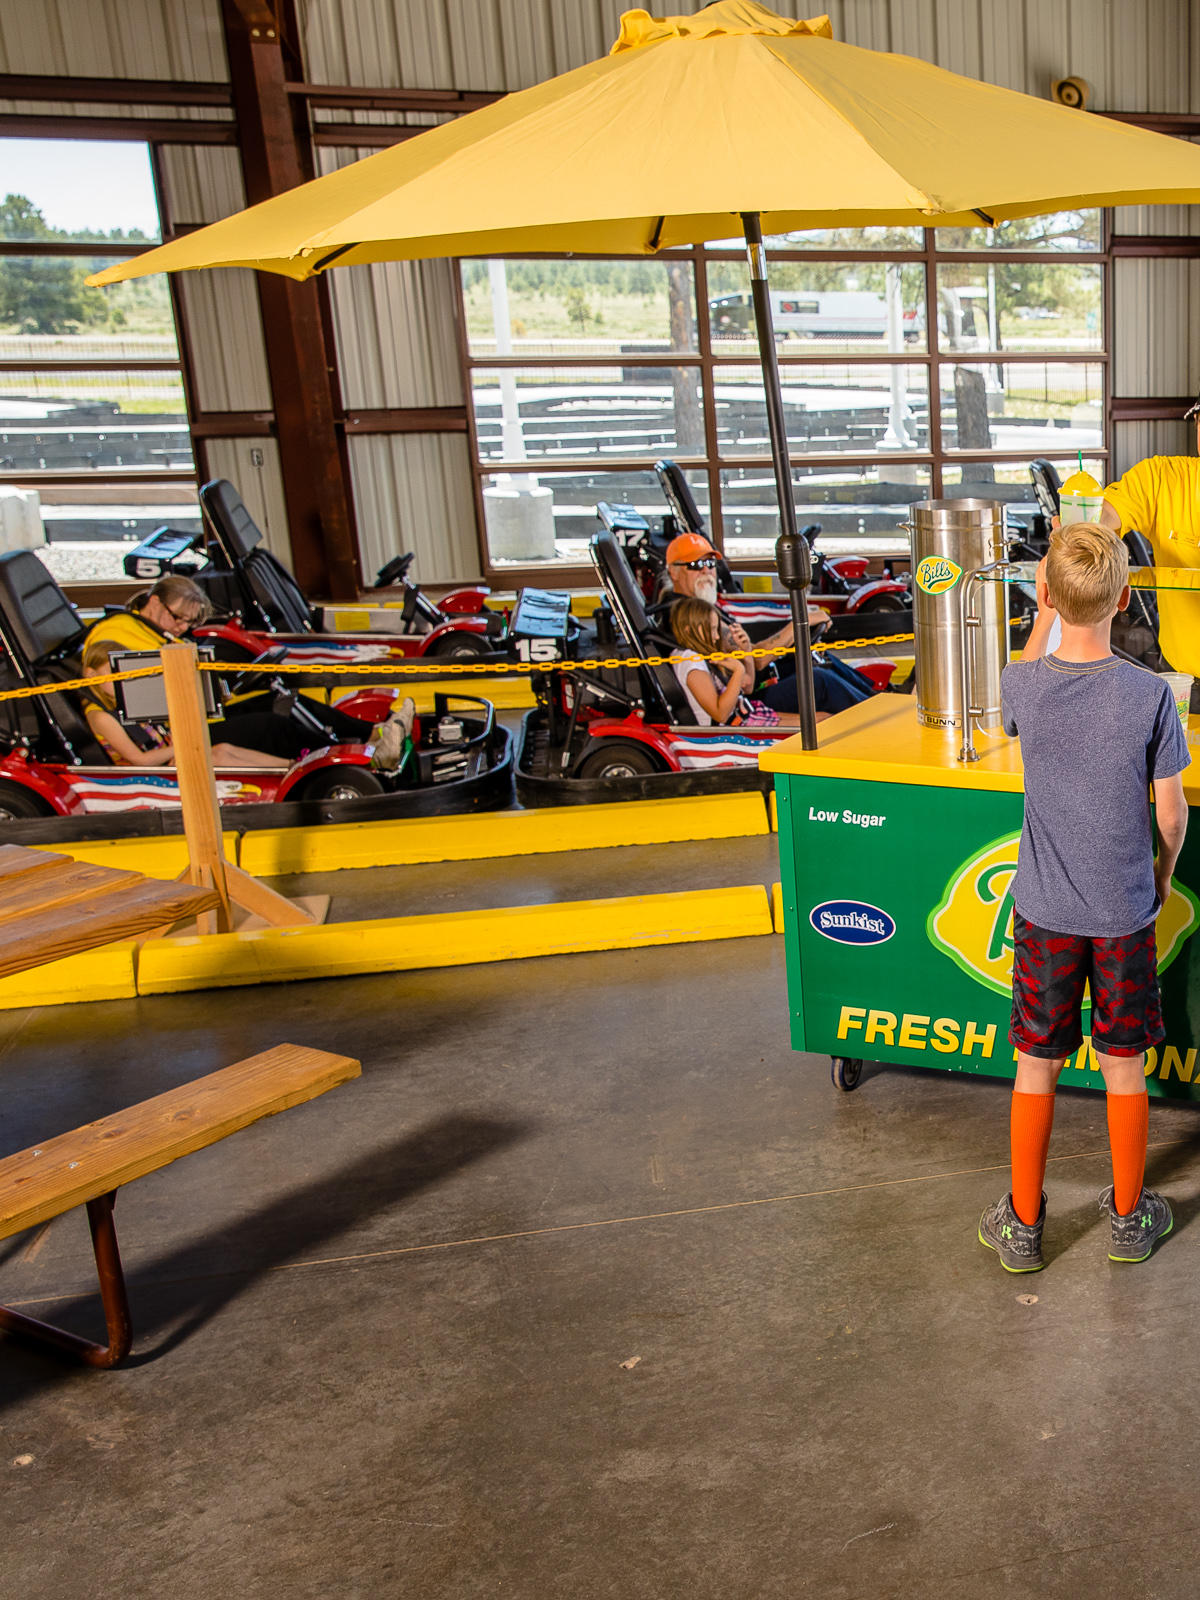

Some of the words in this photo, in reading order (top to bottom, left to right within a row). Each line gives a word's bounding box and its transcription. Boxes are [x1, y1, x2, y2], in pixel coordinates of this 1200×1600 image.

[616, 529, 645, 547] 17
[136, 558, 161, 577] 5
[920, 561, 952, 586] Bill's
[515, 638, 557, 662] 15
[926, 716, 956, 726] BUNN
[809, 806, 839, 823] Low
[842, 809, 886, 828] Sugar
[820, 910, 885, 936] Sunkist
[836, 1006, 998, 1058] FRESH
